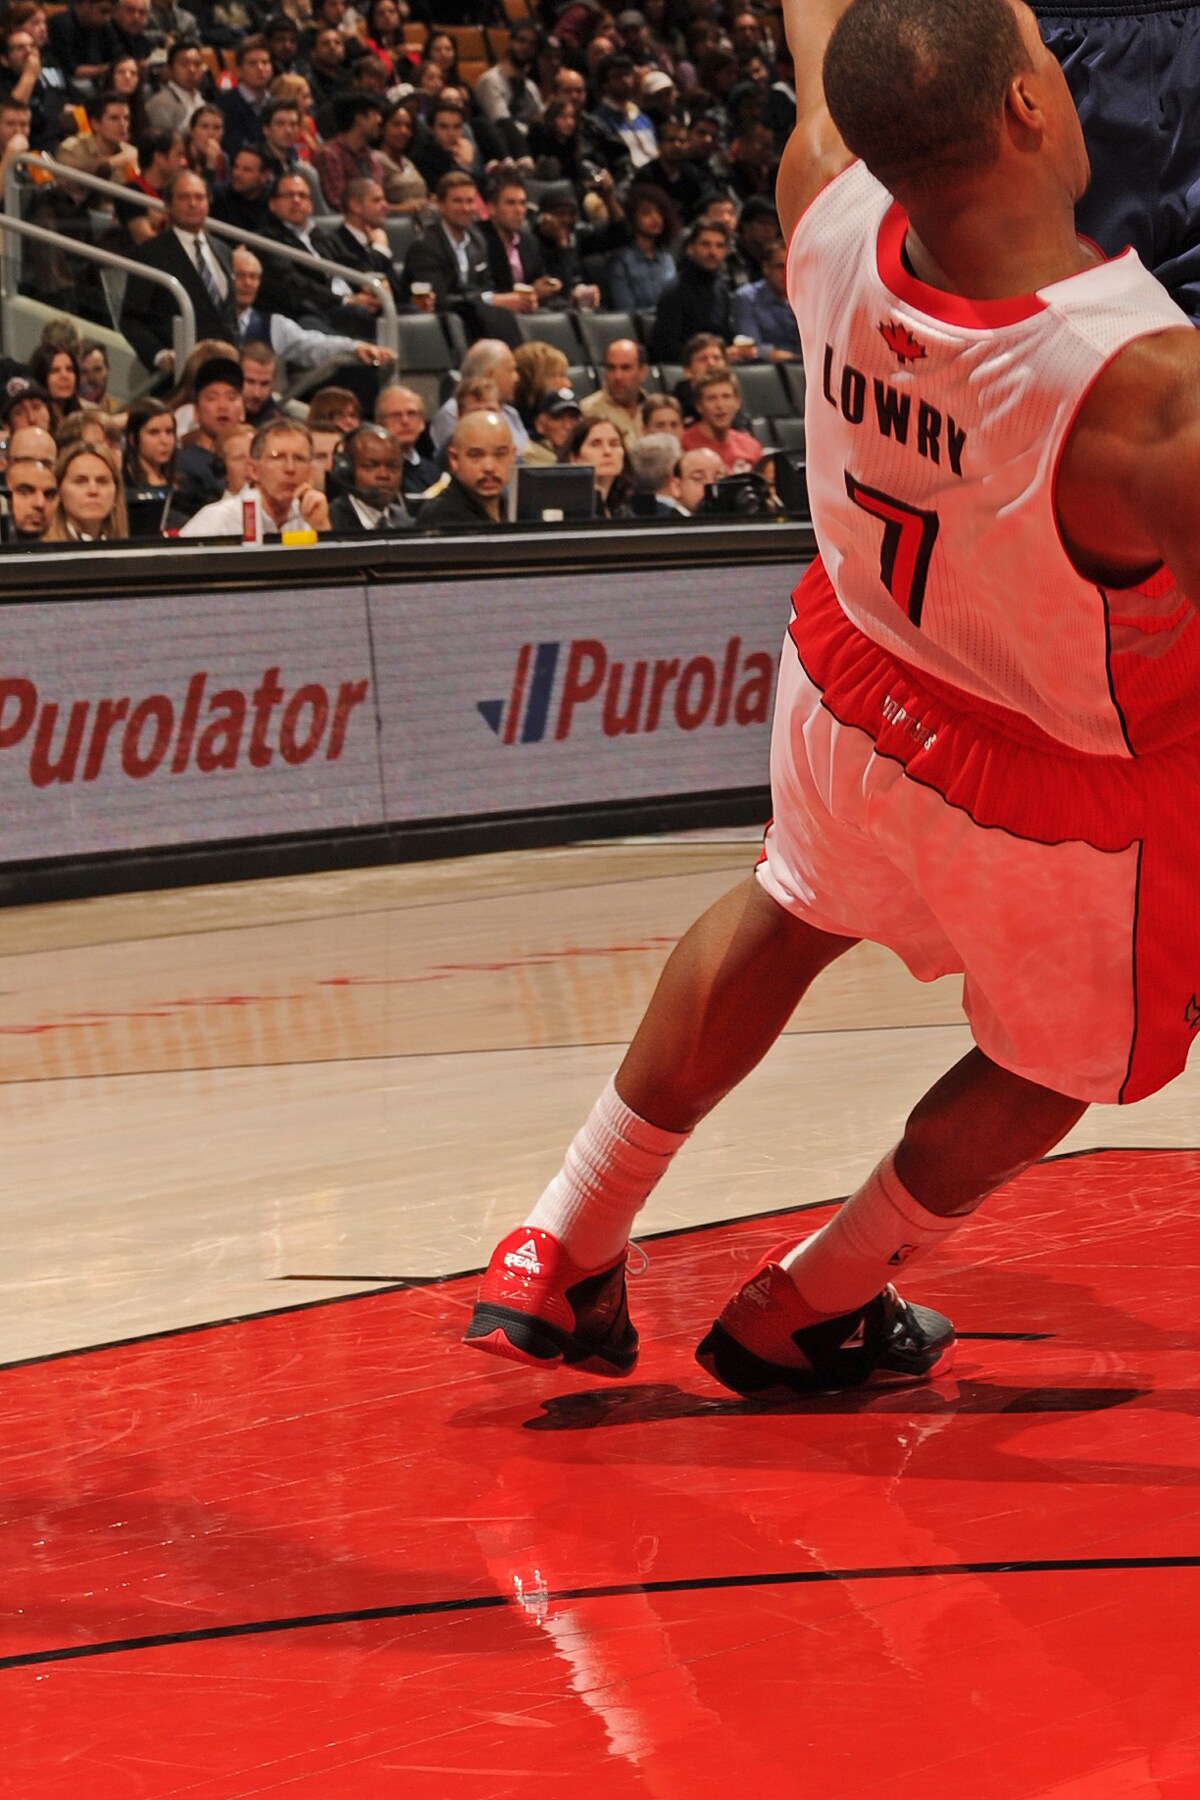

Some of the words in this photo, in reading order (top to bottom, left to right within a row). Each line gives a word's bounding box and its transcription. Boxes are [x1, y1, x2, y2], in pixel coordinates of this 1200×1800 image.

[822, 342, 968, 478] LOWRY
[844, 469, 940, 629] 7
[554, 635, 774, 741] Purola
